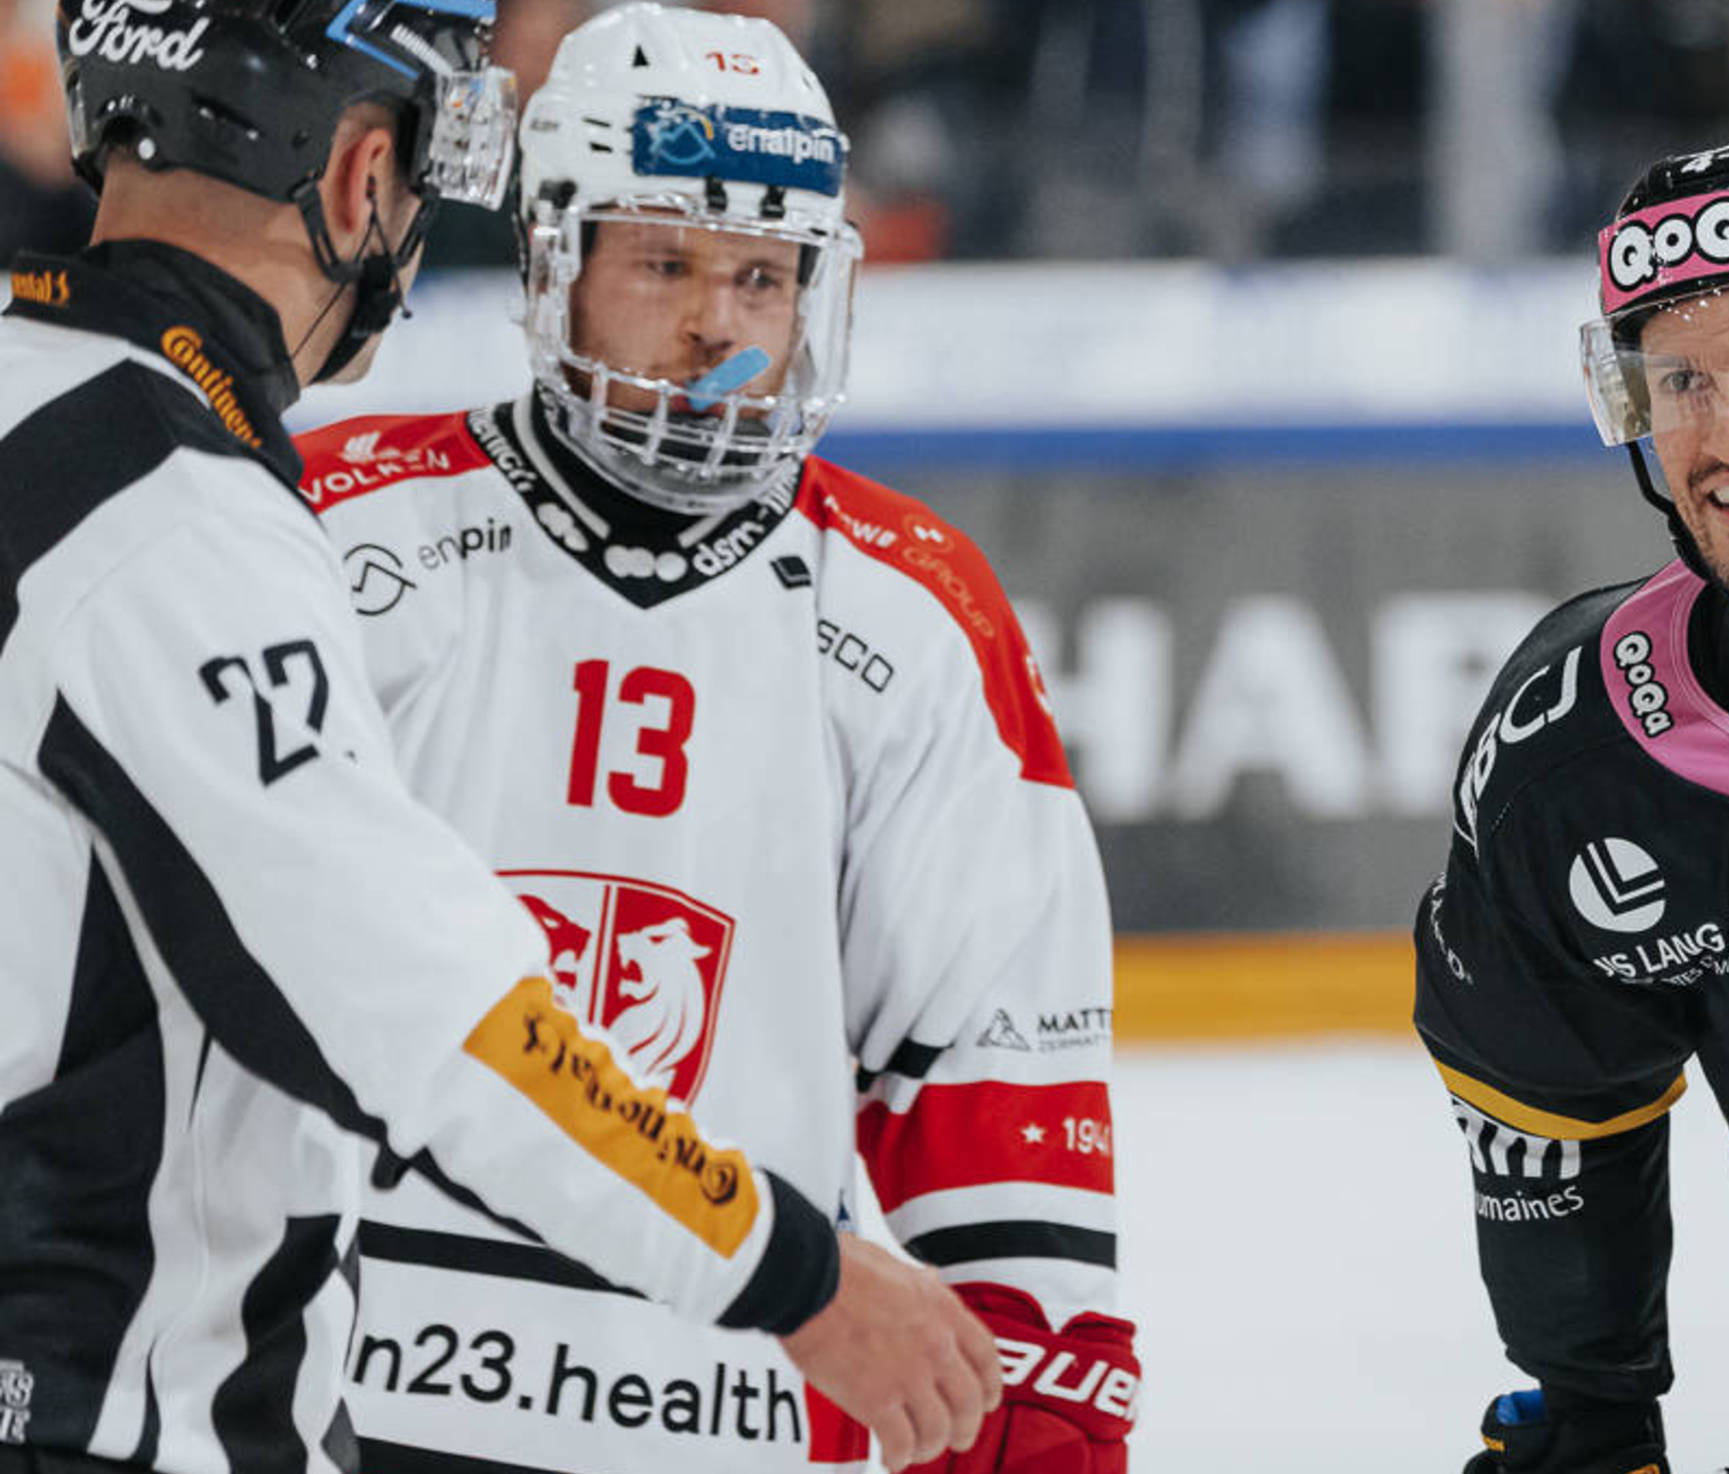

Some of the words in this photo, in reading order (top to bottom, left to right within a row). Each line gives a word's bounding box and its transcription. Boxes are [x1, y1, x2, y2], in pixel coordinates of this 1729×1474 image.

[69, 0, 210, 71] Ford
[161, 325, 262, 449] Continen
[299, 447, 450, 505] VOLKEN
[1614, 631, 1674, 739] QoQa
[566, 658, 697, 818] 13
[1635, 922, 1726, 974] LANG
[993, 1337, 1140, 1423] aue
